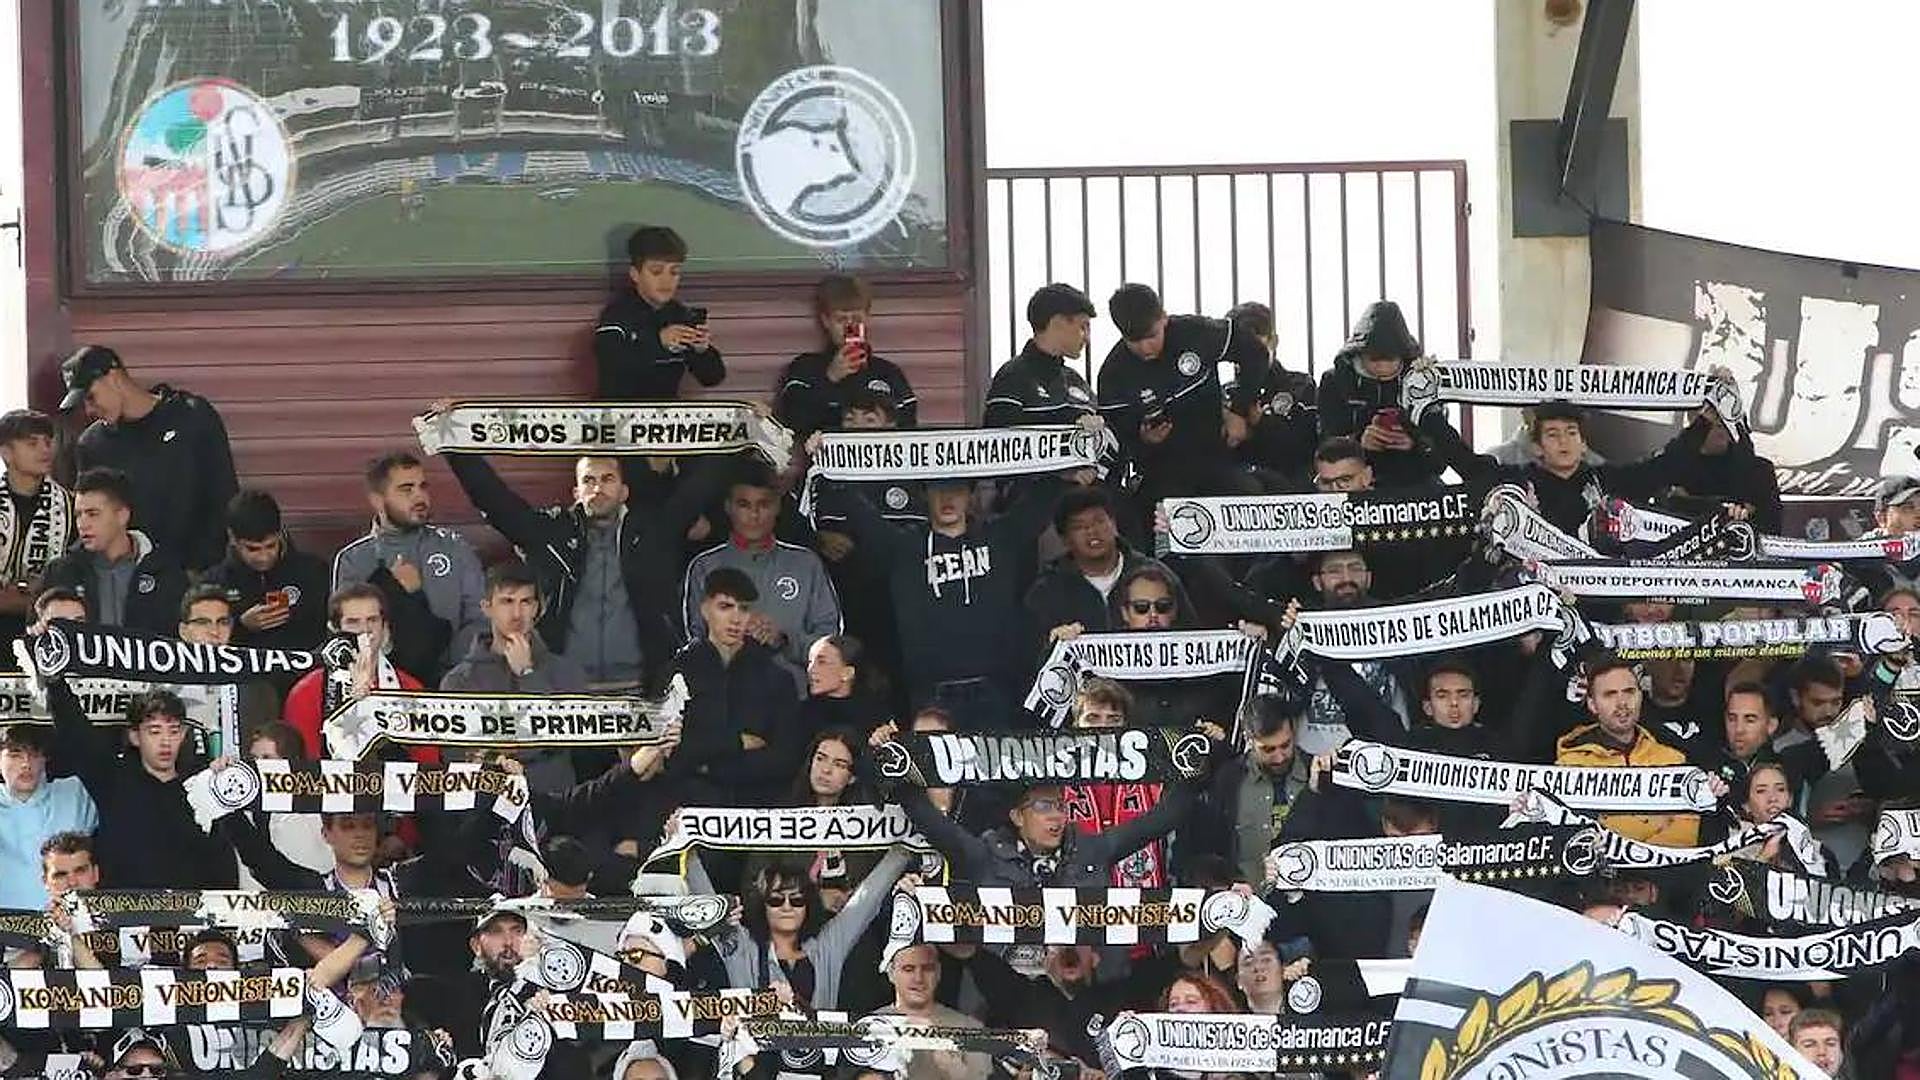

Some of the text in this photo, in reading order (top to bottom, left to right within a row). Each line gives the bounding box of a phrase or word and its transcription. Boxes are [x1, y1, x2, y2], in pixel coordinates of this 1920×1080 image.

[1450, 366, 1547, 392] UNIONISTAS
[1554, 369, 1574, 392] DE
[1580, 369, 1677, 395] SALAMANCA
[581, 423, 616, 444] DE
[910, 442, 929, 467] DE
[935, 437, 1033, 466] SALAMANCA
[1038, 434, 1058, 459] CF
[1220, 503, 1319, 531] UNIONISTAS
[1319, 504, 1342, 529] de
[1343, 498, 1440, 526] Salamanca
[1611, 576, 1698, 588] DEPORTIVA
[1701, 577, 1798, 589] SALAMANCA
[1313, 618, 1407, 647] UNIONISTAS
[1413, 615, 1433, 641] DE
[1438, 595, 1533, 637] SALAMANCA
[1700, 617, 1850, 648] POPULAR
[76, 633, 313, 674] UNIONISTAS
[1074, 643, 1153, 668] ONISTAS
[1159, 642, 1179, 667] DE
[480, 712, 516, 735] DE
[928, 730, 1149, 783] UNIONISTAS
[265, 771, 384, 795] KOMANDO
[1411, 758, 1510, 792] UNIONISTAS
[1543, 770, 1642, 798] SALAMANCA
[1649, 773, 1672, 798] CF
[1326, 844, 1413, 871] UNIONISTAS
[1414, 844, 1435, 868] de
[1436, 841, 1525, 867] Salamanca
[925, 903, 1042, 926] KOMANDO
[1653, 921, 1903, 970] UNIONISTAS
[18, 985, 144, 1011] KOMANDO
[545, 999, 661, 1023] KOMANDO
[186, 1023, 413, 1074] UNIISTAS
[1157, 1020, 1248, 1049] UNIONISTAS
[1248, 1024, 1270, 1050] de
[1270, 1020, 1362, 1050] Salamanca
